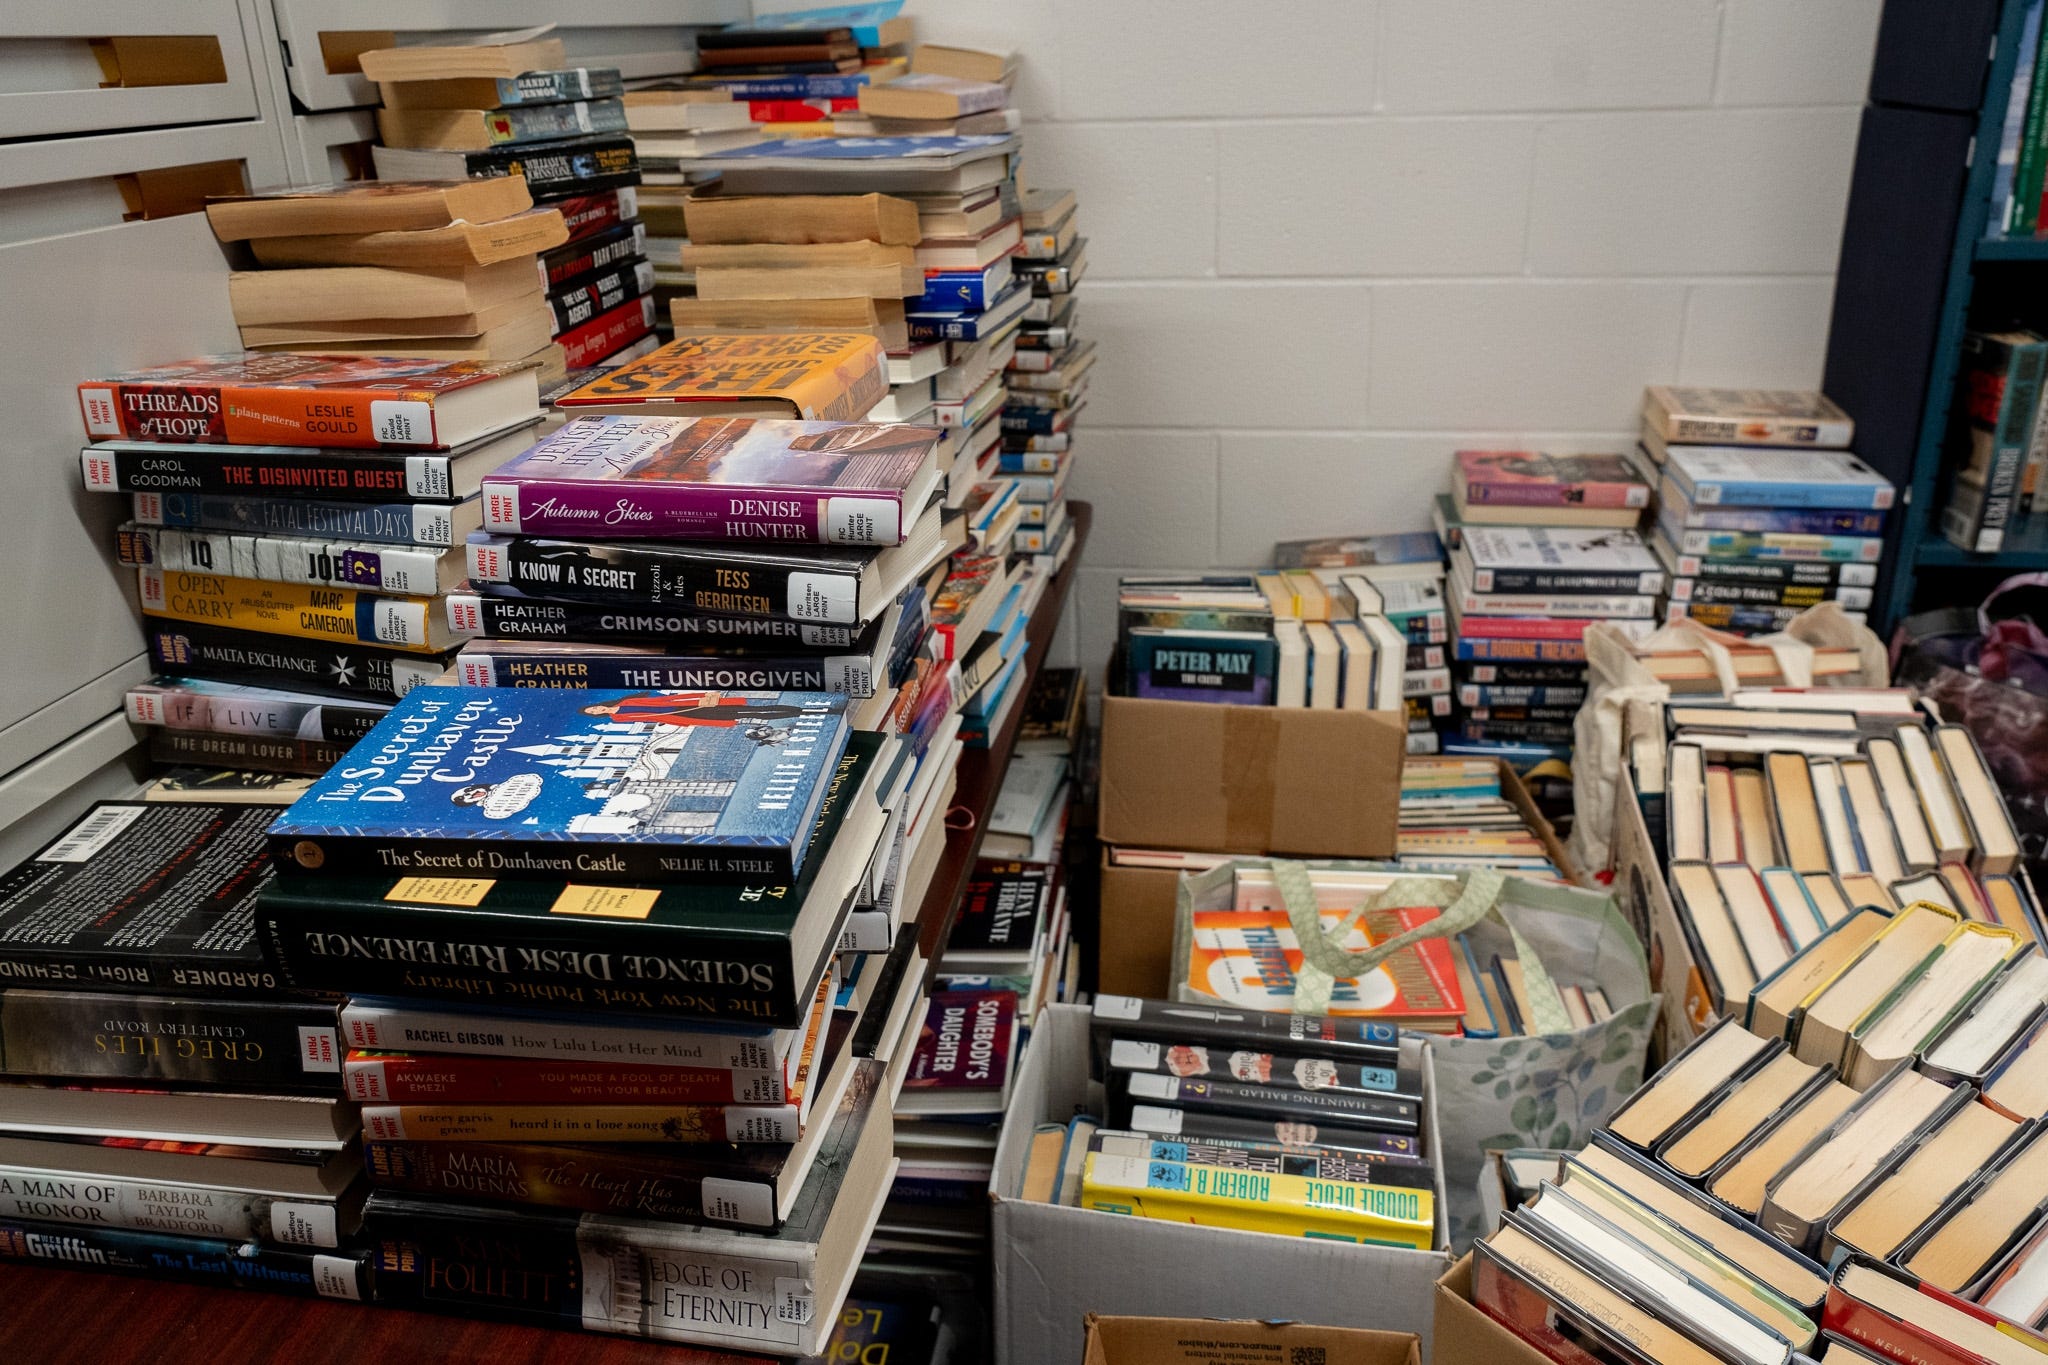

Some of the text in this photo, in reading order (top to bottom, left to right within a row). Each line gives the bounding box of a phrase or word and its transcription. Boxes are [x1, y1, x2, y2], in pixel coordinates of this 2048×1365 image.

[596, 272, 622, 293] ROBERT
[562, 287, 589, 308] THE LAST
[568, 300, 592, 326] AGENT
[631, 358, 822, 373] JOHANSEN
[592, 368, 810, 394] IRIS
[92, 398, 101, 424] LARGE
[101, 400, 111, 424] PRINT
[124, 392, 219, 414] THREADS
[306, 404, 355, 419] LESLIE
[156, 418, 211, 437] HOPE
[306, 420, 358, 434] GOULD
[389, 418, 397, 440] Gould
[528, 424, 605, 463] DENISE
[560, 422, 643, 467] HUNTER
[91, 458, 100, 485] LARGE
[102, 459, 112, 485] PRINT
[141, 459, 186, 472] CAROL
[222, 465, 406, 489] THE DISINVITED GUEST
[129, 473, 201, 488] GOODMAN
[490, 493, 501, 524] LARGE
[503, 495, 513, 523] PRINT
[521, 497, 654, 525] Autumn Skies
[729, 498, 802, 518] DENISE
[306, 503, 410, 538] FESTIVAL DAYS
[725, 520, 809, 540] HUNTER
[847, 514, 856, 541] Hunter
[856, 512, 865, 542] LARGE
[865, 516, 874, 542] PRINT
[189, 539, 213, 570] IQ
[489, 549, 498, 578] PRINT
[308, 552, 345, 582] JOE
[519, 560, 637, 590] KNOW A SECRET
[715, 567, 750, 590] TESS
[177, 573, 226, 596] OPEN
[171, 594, 235, 620] CARRY
[310, 589, 344, 611] MARC
[695, 590, 771, 614] GERRITSEN
[805, 582, 813, 617] Gerritsen
[812, 590, 821, 618] LARGE
[821, 594, 829, 618] PRINT
[299, 611, 356, 636] CAMERON
[467, 604, 477, 630] PRINT
[494, 604, 567, 620] HEATHER
[498, 621, 568, 635] GRAHAM
[600, 614, 798, 637] CRIMSON SUMMER
[203, 646, 318, 674] MALTA EXCHANGE
[509, 663, 589, 677] HEATHER
[1155, 649, 1252, 674] PETER MAY
[620, 669, 822, 688] THE UNFORGIVEN
[175, 705, 278, 729] IF LIVE
[173, 737, 294, 760] THE DREAM LOVER
[317, 780, 364, 804] The
[341, 714, 438, 780] Secret
[358, 697, 493, 803] Dunhaven
[431, 713, 523, 783] Castle
[377, 849, 627, 873] The Secret of Dunhaven Castle
[659, 856, 775, 874] NELLIE STEELE
[1013, 881, 1038, 918] ELENA
[989, 881, 1019, 943] FERRANTE
[305, 931, 774, 993] REFERENCE DESK SCIENCE
[172, 968, 276, 988] GARDNER
[402, 970, 778, 1018] The New York Public Library
[103, 1019, 246, 1039] ROAD CEMETERY
[1306, 1020, 1321, 1033] JO
[95, 1033, 263, 1061] GREG ILES
[404, 1028, 703, 1058] RACHEL GIBSON How Lulu Lost Her Mind
[932, 1007, 966, 1072] DAUGHTER
[965, 1000, 1000, 1080] SOMEBODY'S
[395, 1073, 457, 1083] AKWAEKE
[409, 1083, 446, 1093] EMEZI
[538, 1072, 721, 1083] YOU MADE FOOL OF DEATH
[569, 1086, 691, 1095] WITH YOUR BEAUTY
[1237, 1088, 1367, 1111] HAUNTING BALLAD
[418, 1113, 494, 1125] tracey garvis
[509, 1118, 622, 1130] heard love
[439, 1126, 477, 1137] graves
[22, 1179, 116, 1204] MAN OF
[138, 1188, 214, 1208] BARBARA
[1210, 1170, 1270, 1203] ROBERT
[1304, 1180, 1355, 1212] DEUCE
[17, 1199, 109, 1223] HONOR
[145, 1203, 209, 1221] TAYLOR
[1360, 1187, 1419, 1221] DOUBLE
[135, 1216, 224, 1235] BRADFORD
[26, 1232, 108, 1265] Griffin
[187, 1254, 312, 1285] Last Witness
[430, 1254, 558, 1302] FOLLETT
[649, 1257, 753, 1293] EDGE OF
[662, 1286, 776, 1330] ETERNITY
[1177, 1339, 1283, 1351] amazon.com/thisbox
[1184, 1350, 1221, 1359] matters
[1224, 1352, 1263, 1361] material
[1874, 1337, 1906, 1357] NEW
